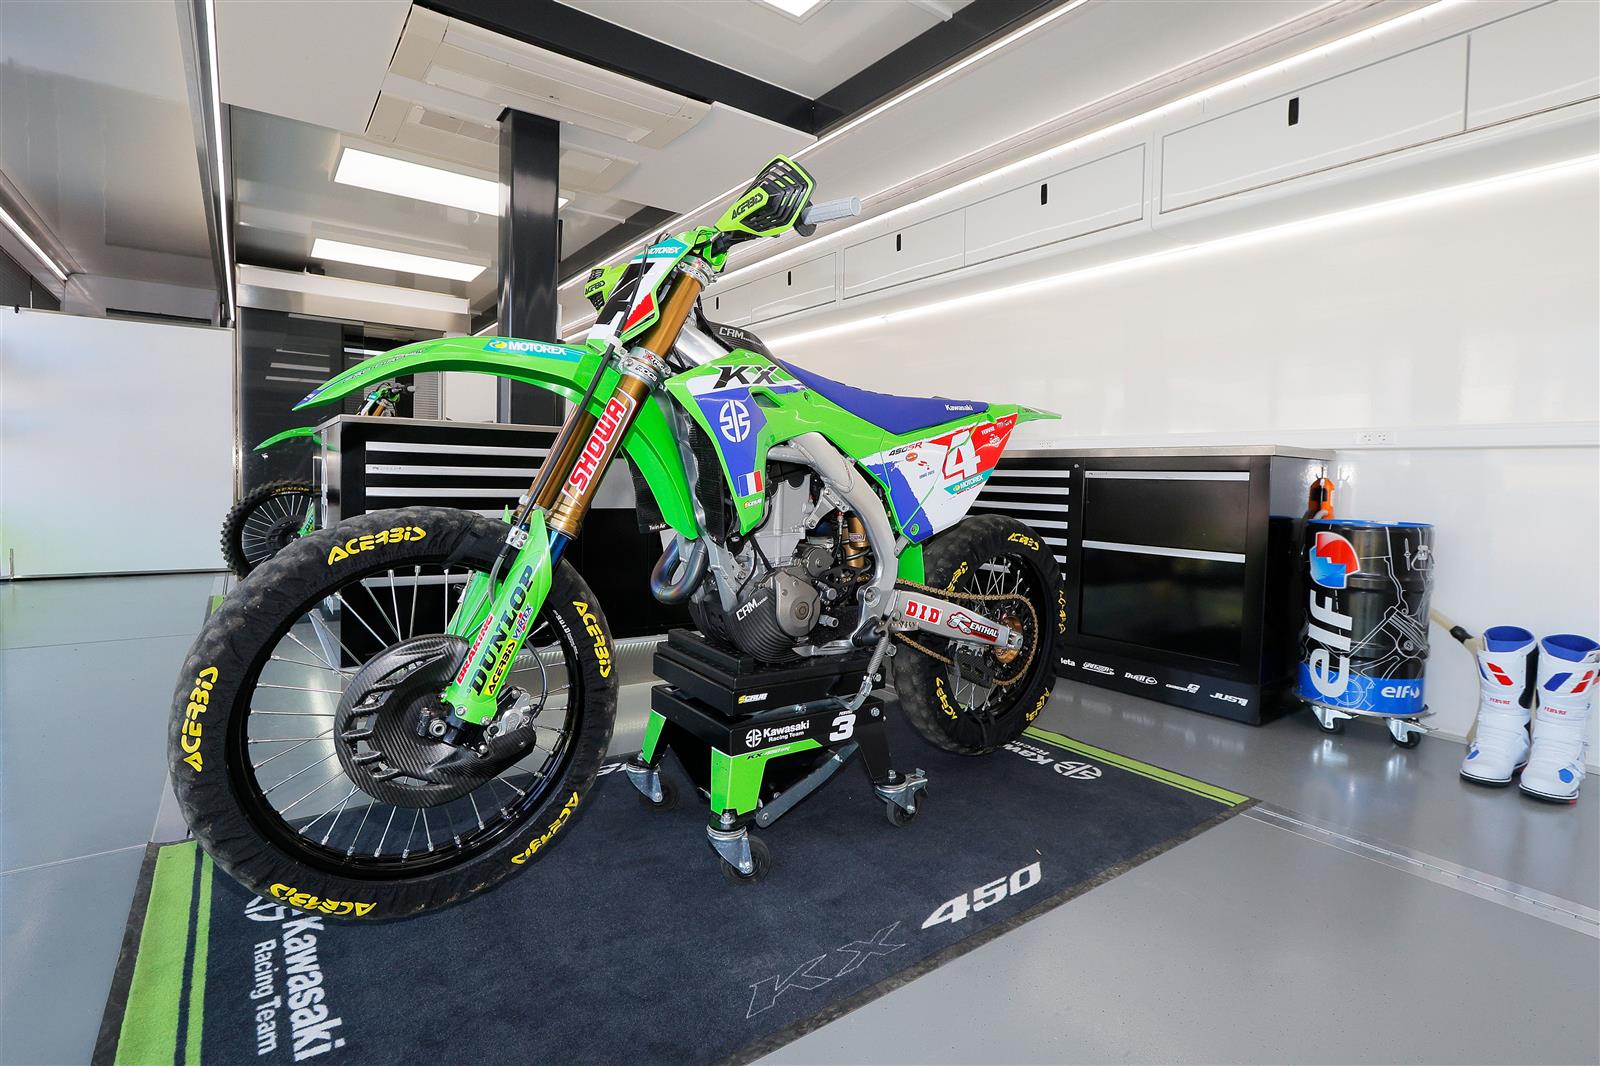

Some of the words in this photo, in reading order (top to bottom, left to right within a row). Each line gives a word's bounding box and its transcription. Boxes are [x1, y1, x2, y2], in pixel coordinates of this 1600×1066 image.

[508, 341, 567, 356] MOTOREX
[719, 327, 744, 340] CRM
[712, 365, 784, 391] KX
[945, 404, 974, 412] Kawasaki
[568, 397, 627, 496] SHOWA
[942, 429, 982, 481] 4
[328, 526, 427, 565] ACERBIS
[467, 565, 533, 696] DUNLOP
[736, 598, 758, 621] CRM
[456, 614, 494, 685] BRAKING
[572, 601, 611, 678] ACERBIS
[1308, 589, 1353, 699] elf
[488, 642, 517, 695] ACERBIS
[1381, 685, 1412, 698] elf
[181, 666, 219, 772] ACERBIS
[763, 720, 810, 738] Kawasaki
[768, 734, 789, 743] Racing
[789, 730, 805, 739] Team
[829, 713, 857, 742] 3
[511, 791, 580, 866] ACERBIS
[269, 883, 377, 917] ACERBIS
[920, 861, 1042, 930] 450
[249, 938, 278, 1001] Racing
[281, 915, 346, 1063] Kawasaki
[746, 920, 907, 1019] KX
[255, 994, 283, 1057] Team
